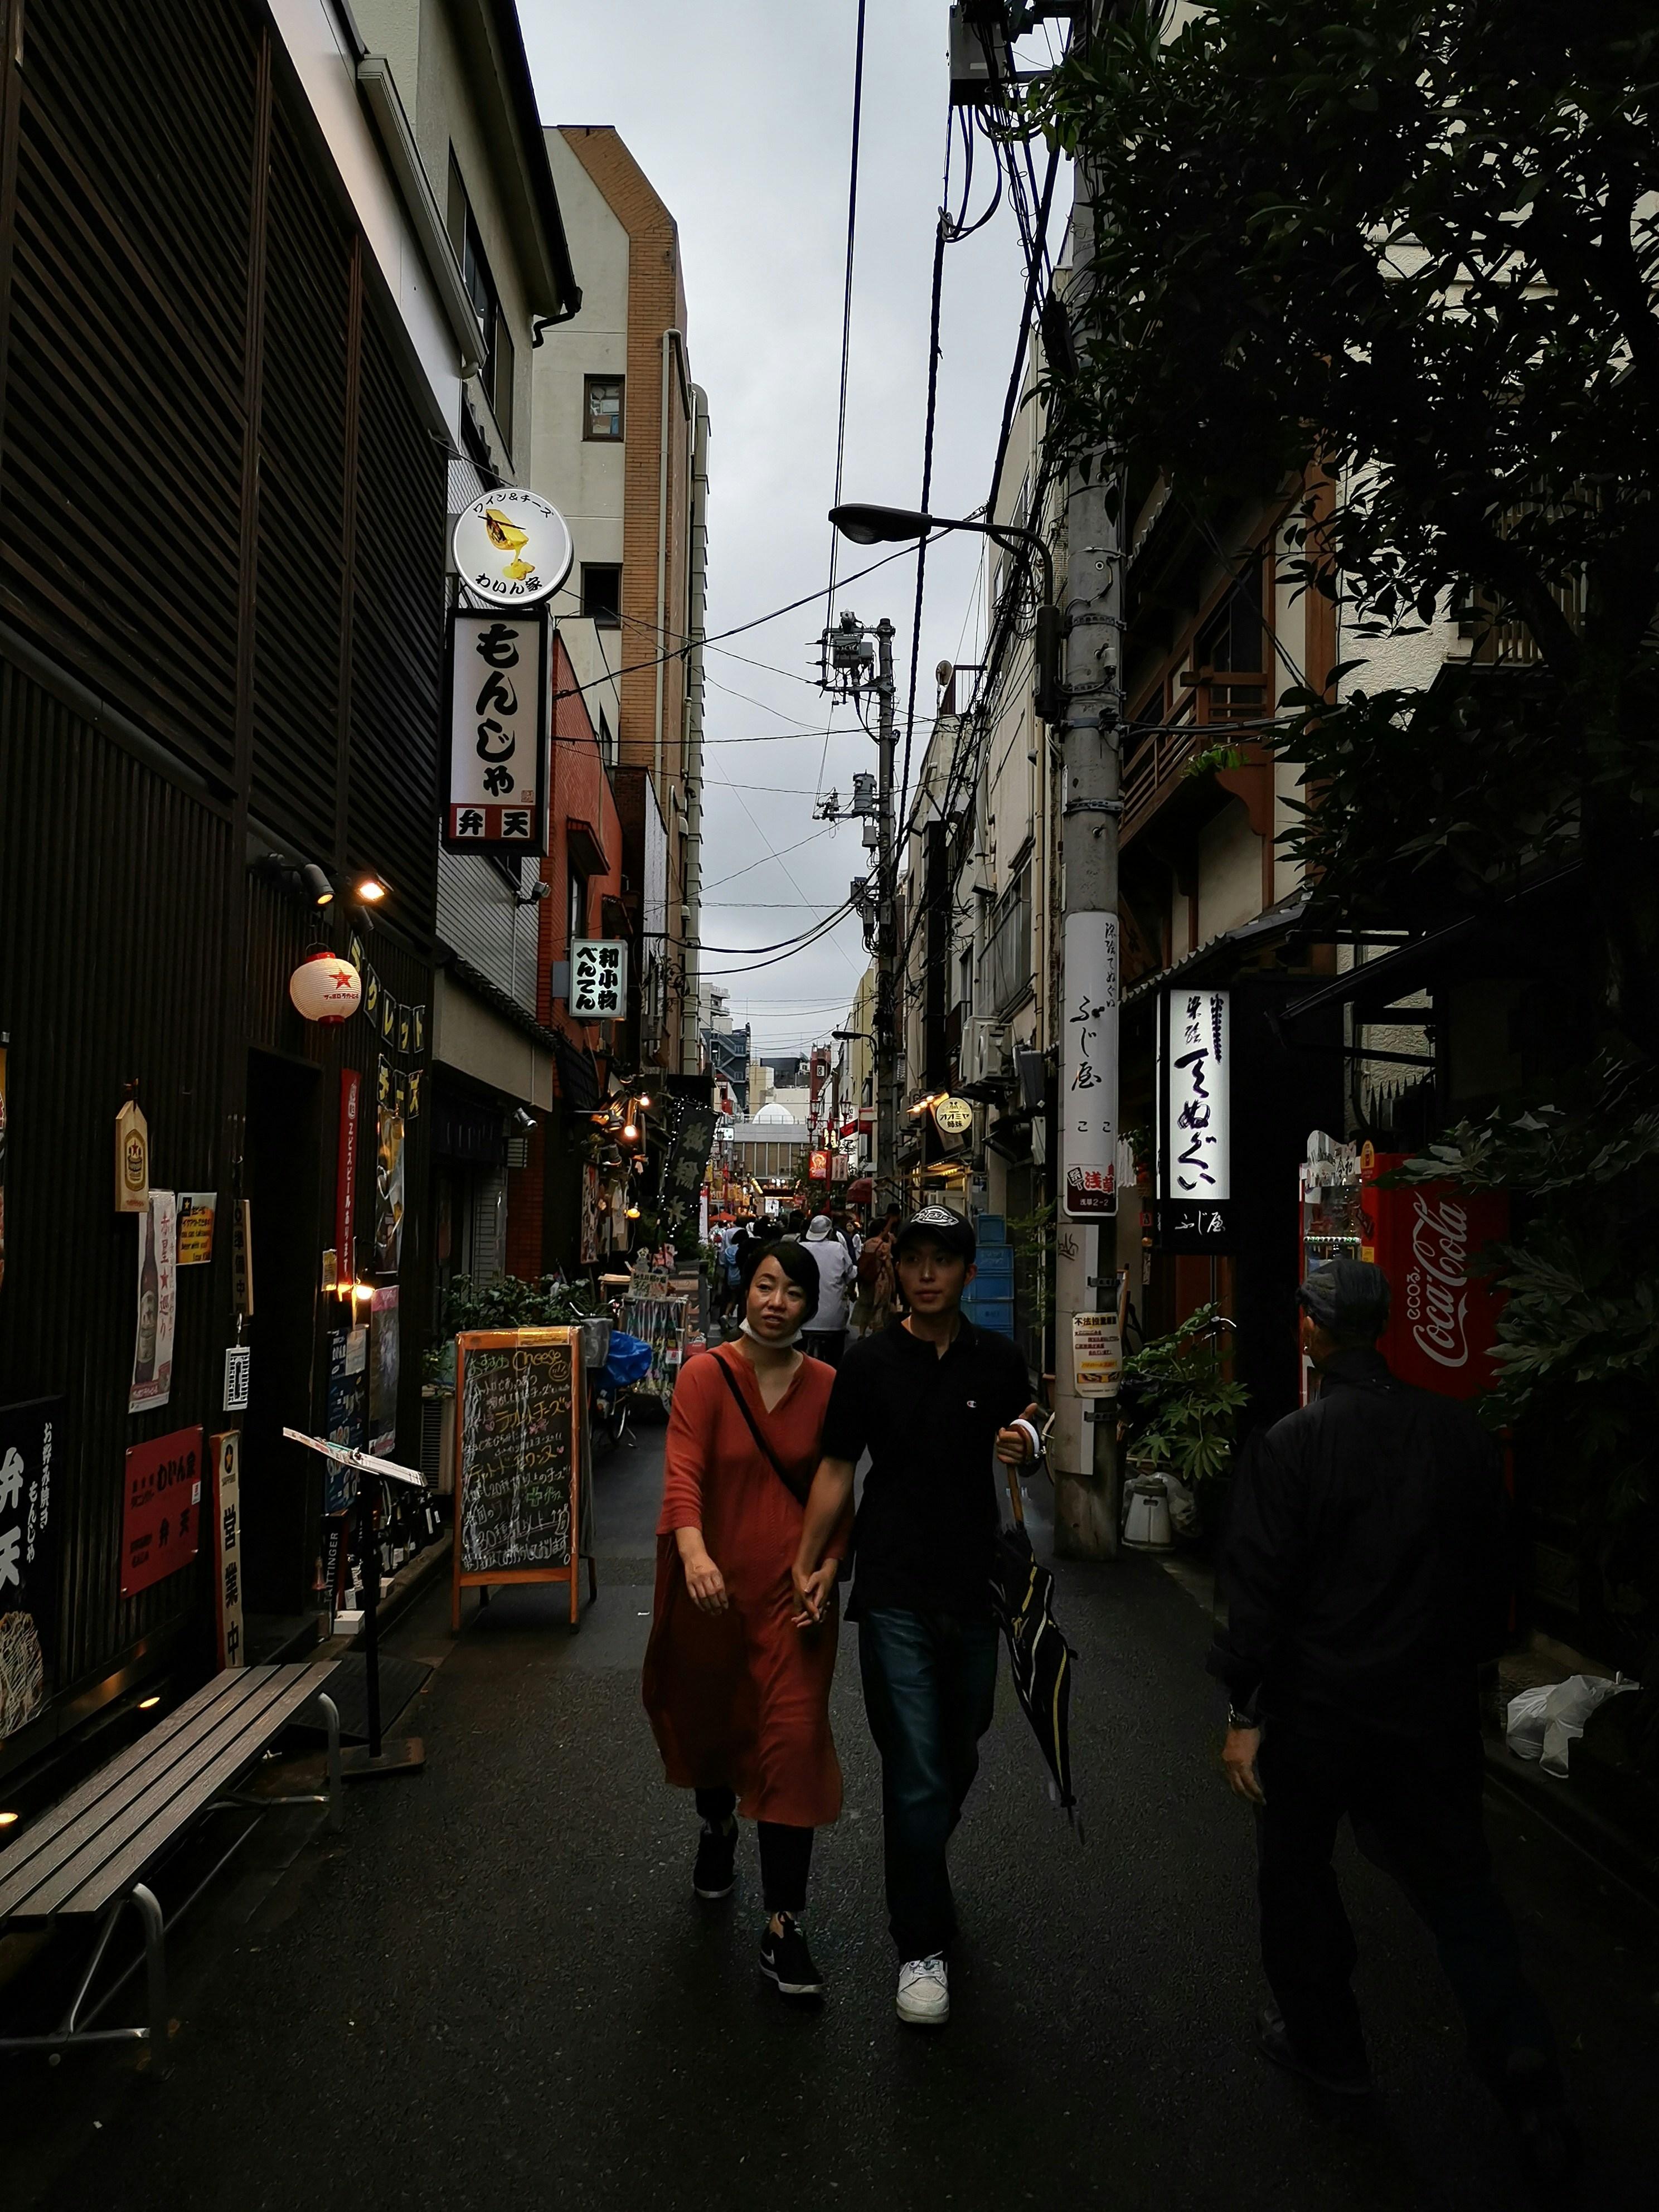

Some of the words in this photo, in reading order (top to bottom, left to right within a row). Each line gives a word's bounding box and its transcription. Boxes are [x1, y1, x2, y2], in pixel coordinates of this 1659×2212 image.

[472, 491, 555, 520] ワイン&チーズ
[474, 573, 544, 595] わいん家
[475, 623, 520, 798] もんじゃ
[458, 809, 530, 837] 弁天
[576, 946, 597, 1011] べんてん
[598, 947, 619, 1011] 和小物
[1069, 1168, 1080, 1181] 祭
[1085, 1171, 1114, 1194] 浅草
[1413, 1191, 1468, 1367] Coca-Cola
[512, 1349, 562, 1371] Cheese
[26, 1480, 38, 1564] もんじゃ
[224, 1503, 239, 1666] 営業中
[323, 1532, 339, 1604] TAITTINGER
